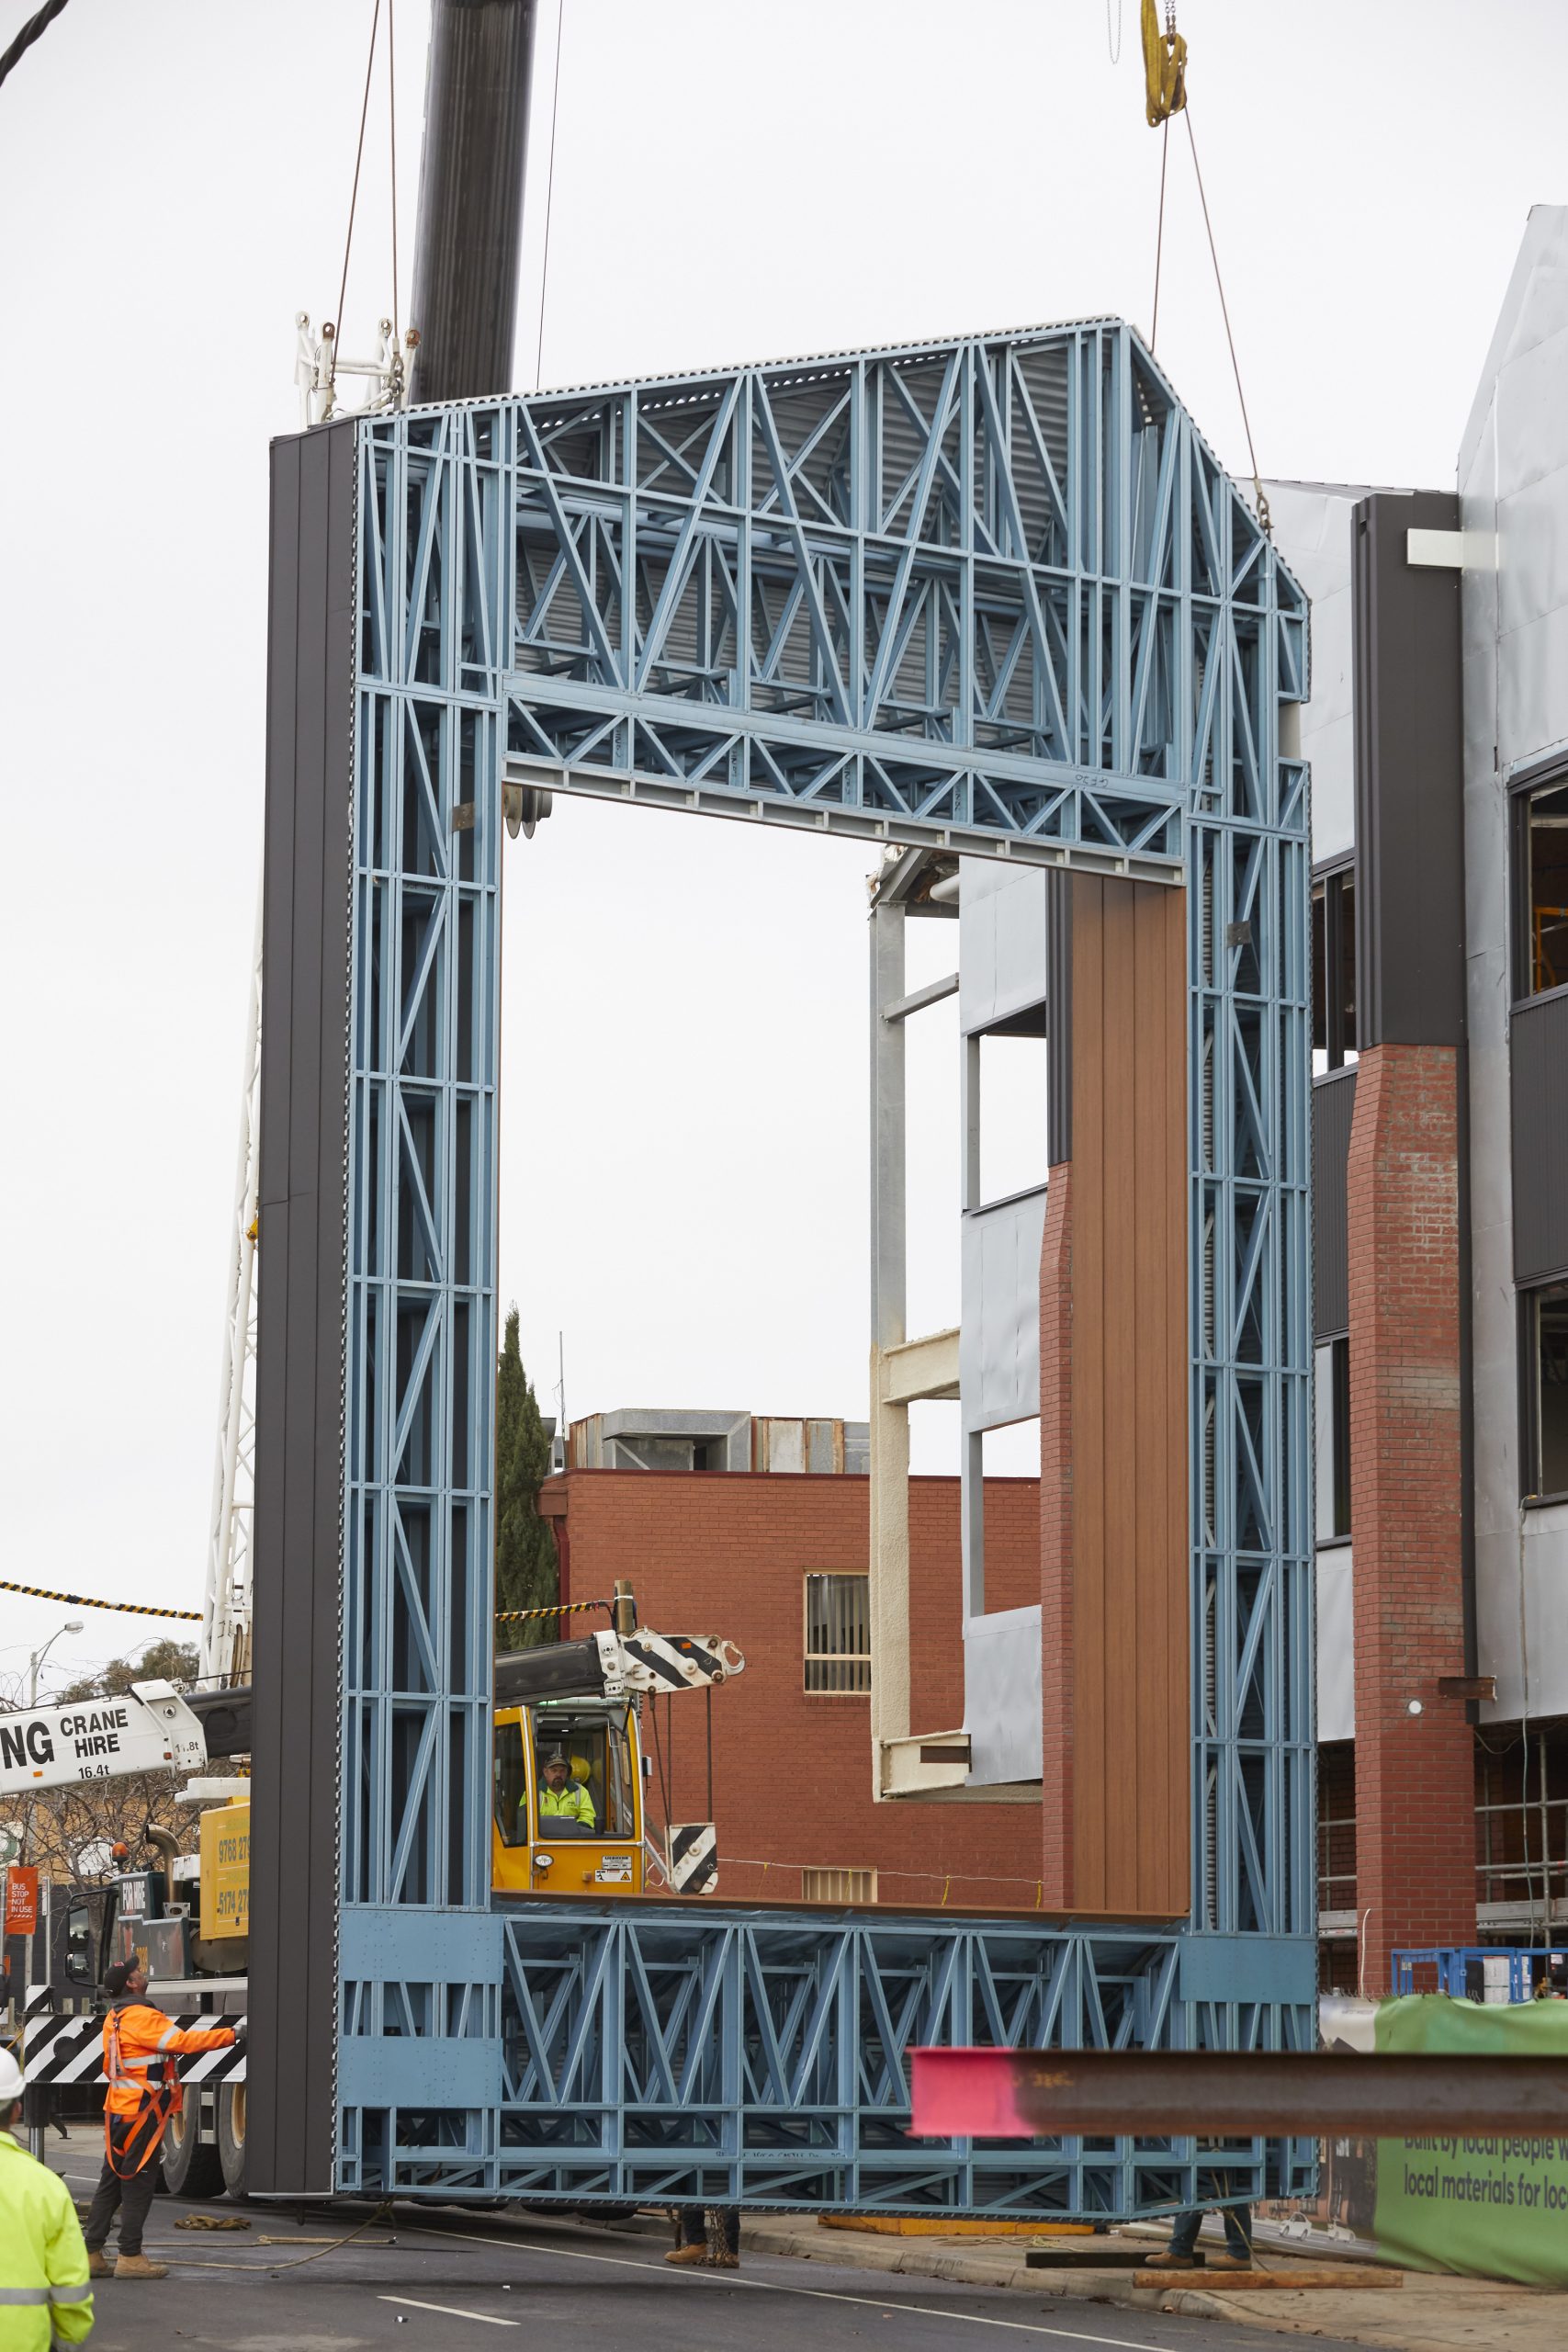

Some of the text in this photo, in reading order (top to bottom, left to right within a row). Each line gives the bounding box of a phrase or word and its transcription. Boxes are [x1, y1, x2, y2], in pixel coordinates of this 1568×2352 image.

[60, 1708, 129, 1737] CRANE
[0, 1721, 55, 1770] NG
[74, 1733, 120, 1758] HIRE
[78, 1764, 110, 1780] 16.4t
[219, 1838, 237, 1863] 9768
[11, 1883, 26, 1891] BUS
[19, 1905, 33, 1914] USE
[219, 1890, 236, 1916] 5174
[1503, 2137, 1554, 2165] people
[1404, 2163, 1568, 2210] local materials for loc
